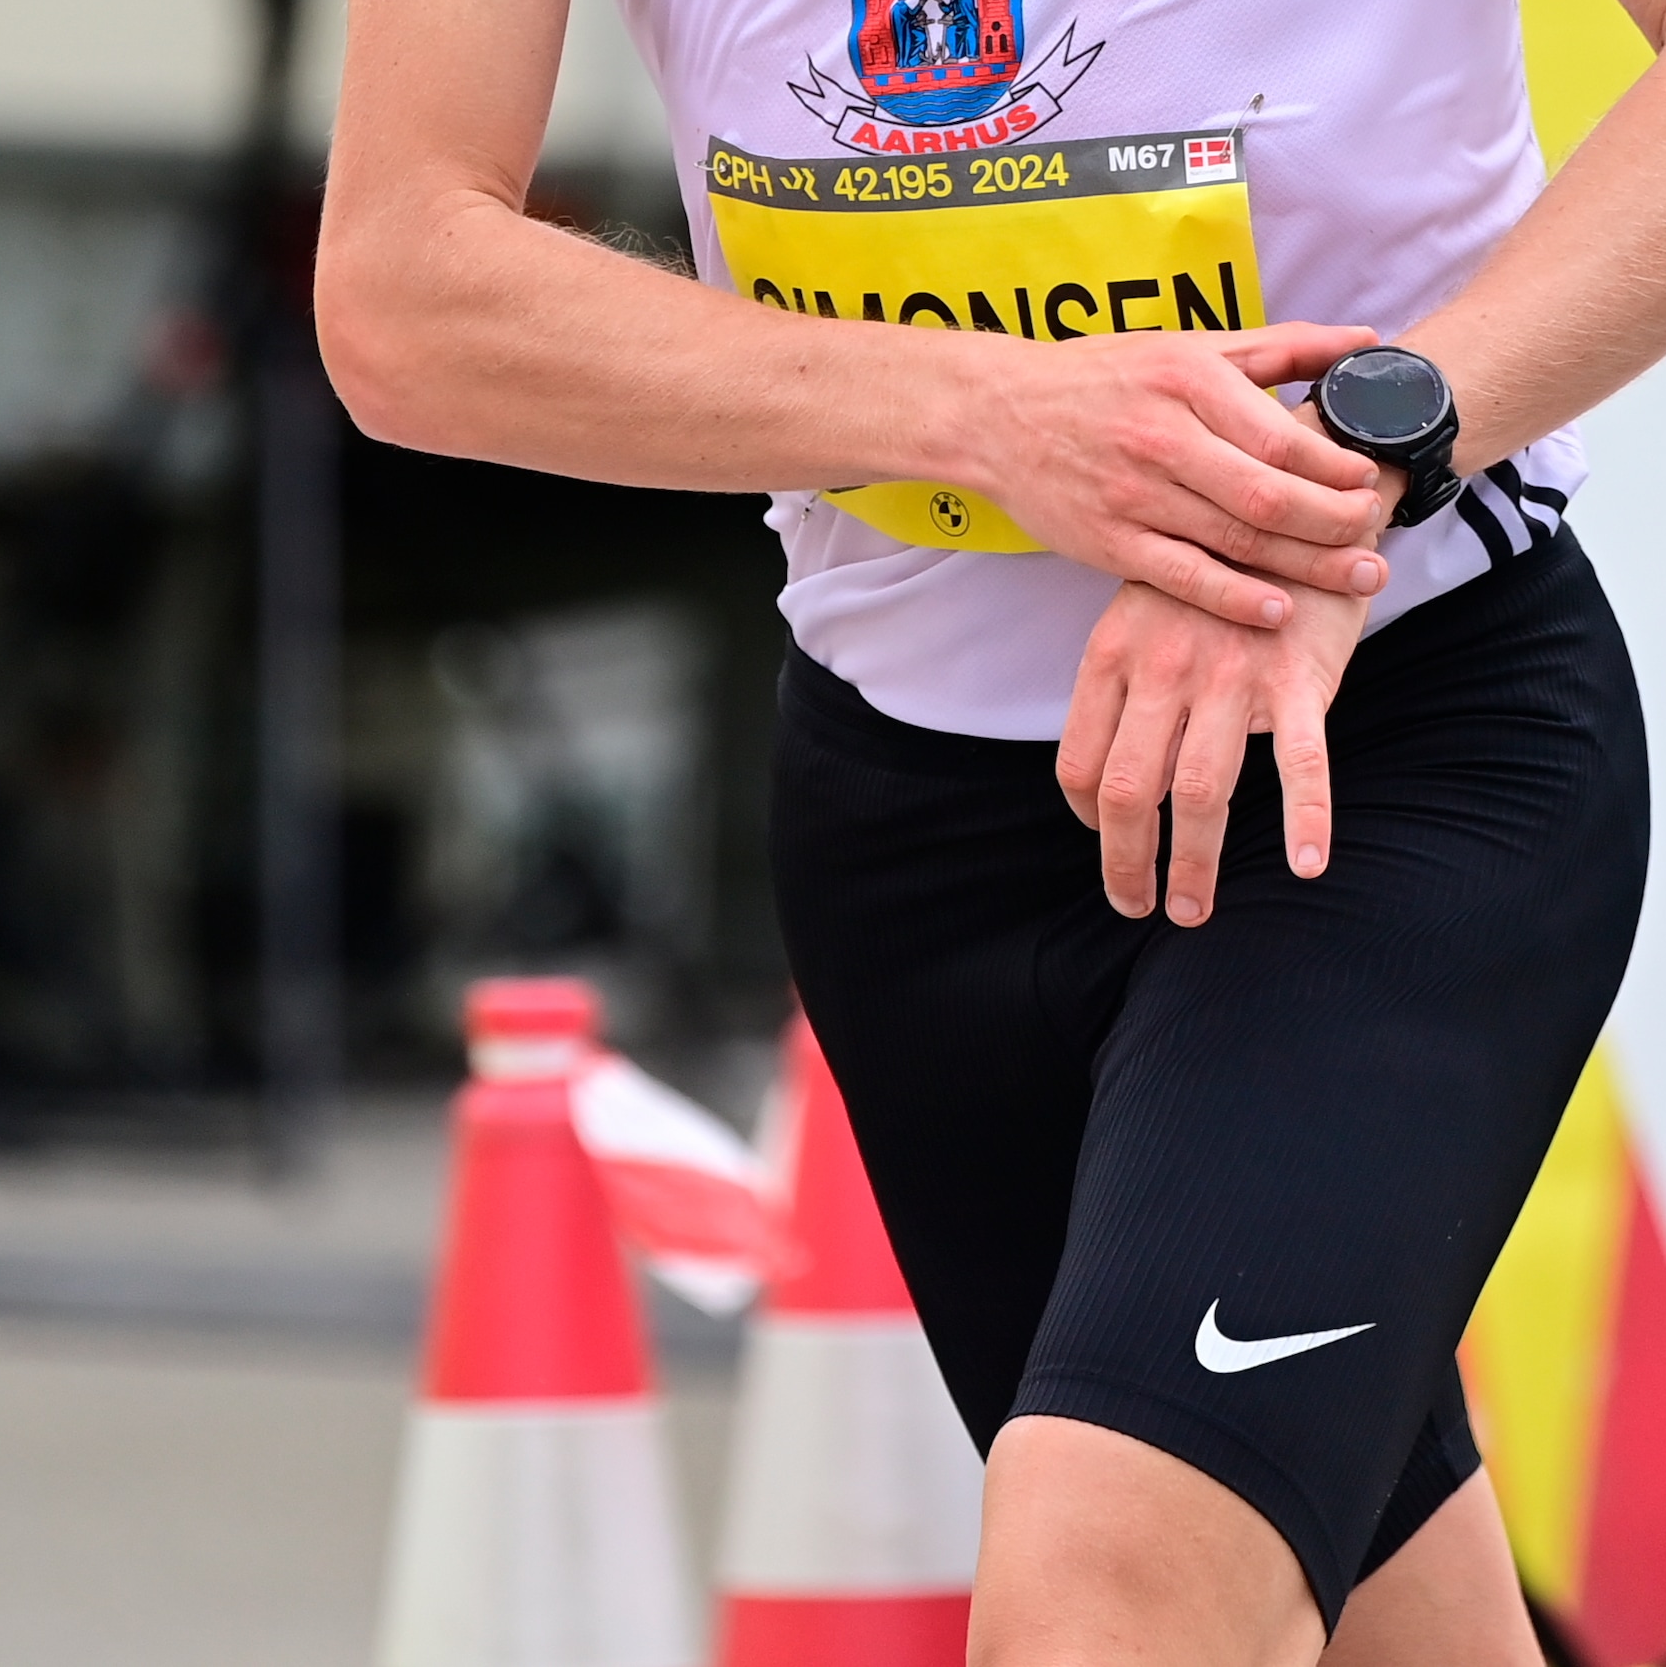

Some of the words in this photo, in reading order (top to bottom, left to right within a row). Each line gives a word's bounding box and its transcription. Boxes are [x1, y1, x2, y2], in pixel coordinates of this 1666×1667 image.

[850, 103, 1038, 155] AARHUS
[712, 150, 775, 198] CPH
[833, 162, 954, 202] 42.195
[969, 151, 1070, 194] 2024
[1107, 143, 1175, 172] M67
